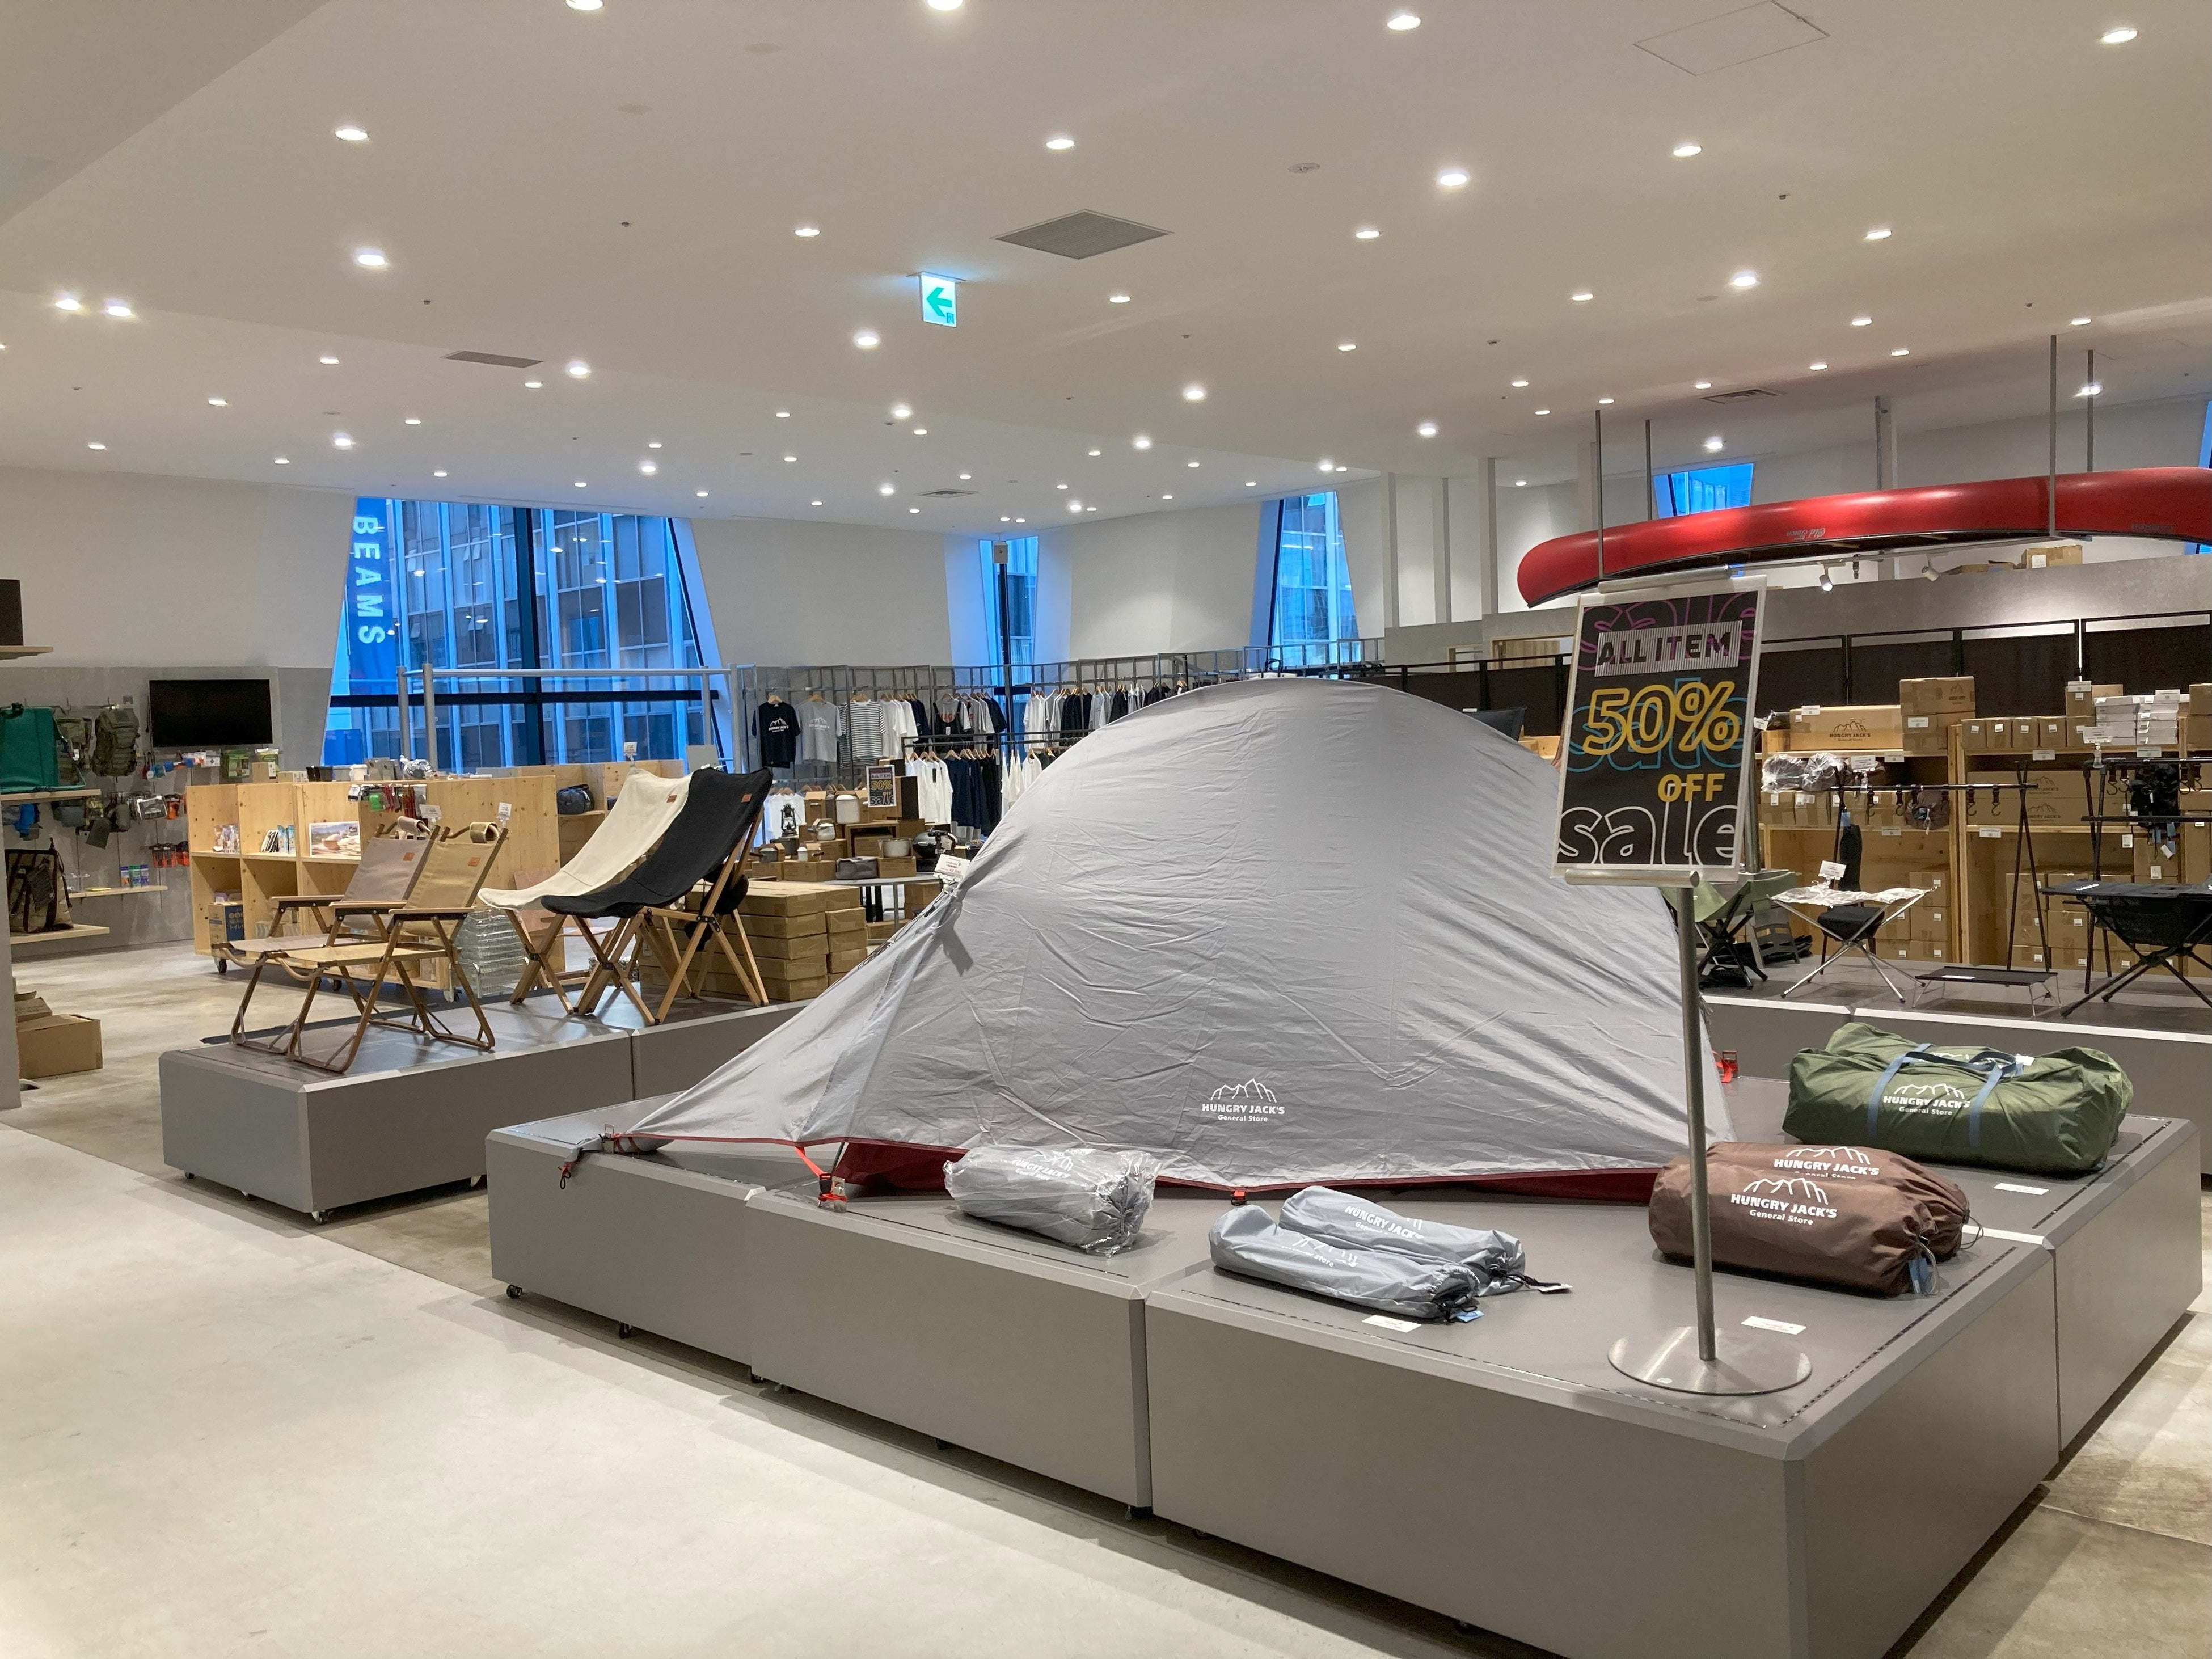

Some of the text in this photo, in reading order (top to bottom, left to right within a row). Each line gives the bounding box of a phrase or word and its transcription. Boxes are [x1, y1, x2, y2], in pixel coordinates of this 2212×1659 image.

[353, 516, 386, 644] BEAMS
[1597, 632, 1731, 666] ALL ITEM
[1582, 681, 1740, 755] 50%
[871, 780, 893, 790] 50%
[1658, 773, 1725, 803] OFF
[870, 794, 894, 805] sale
[1557, 782, 1738, 866] sale
[1202, 1103, 1285, 1115] HUNGRY JACK'S
[1883, 1095, 1931, 1106] HUNGRY
[1774, 1159, 1832, 1171] HUNGRY
[1833, 1163, 1880, 1176] JACK'S
[1730, 1193, 1838, 1219] HUNGRY JACK'S
[1344, 1206, 1390, 1229] HUNGRY
[1749, 1209, 1814, 1225] General Store
[1355, 1221, 1383, 1234] Gene
[1314, 1255, 1335, 1268] Store
